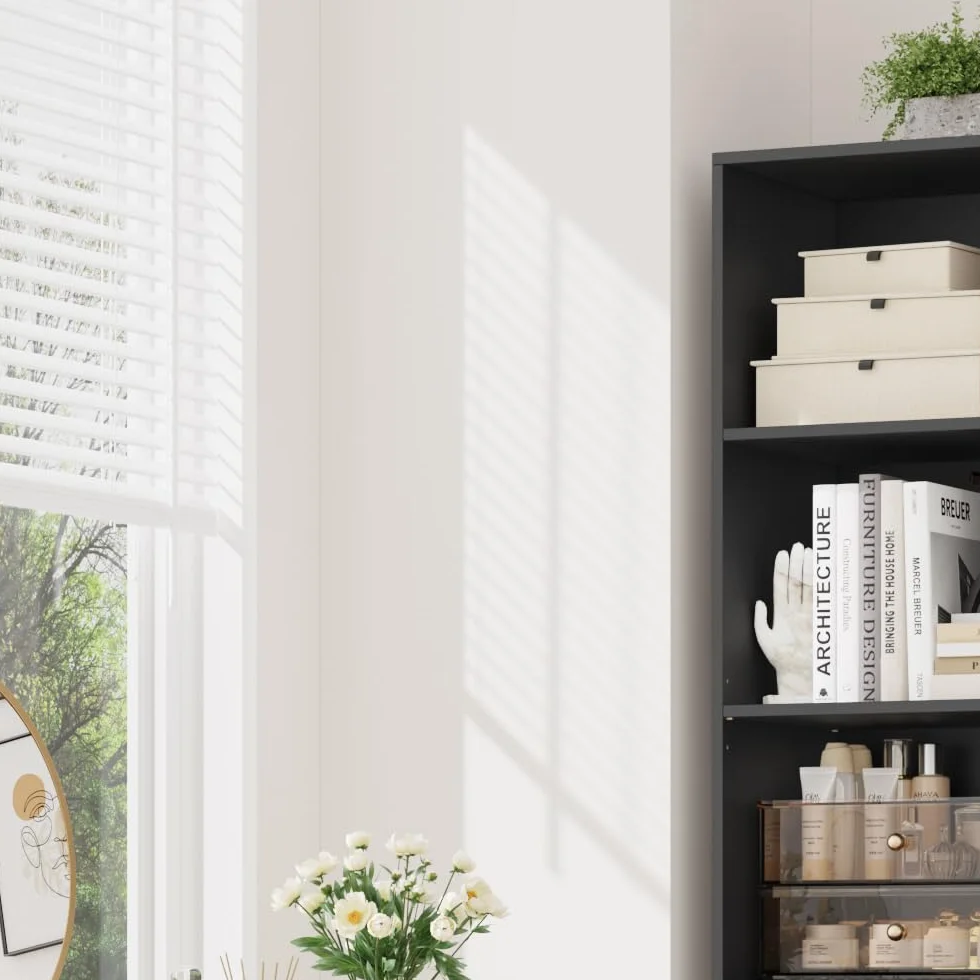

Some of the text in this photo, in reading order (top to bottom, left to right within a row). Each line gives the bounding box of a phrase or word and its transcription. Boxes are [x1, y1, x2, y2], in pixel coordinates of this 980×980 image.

[940, 497, 971, 522] BREUER
[816, 506, 831, 676] ARCHITECTURE
[862, 479, 876, 702] FURNITURE DESIGN
[885, 530, 895, 654] BRINGING THE HOUSE HOME
[912, 557, 922, 636] MARCEL BREUER
